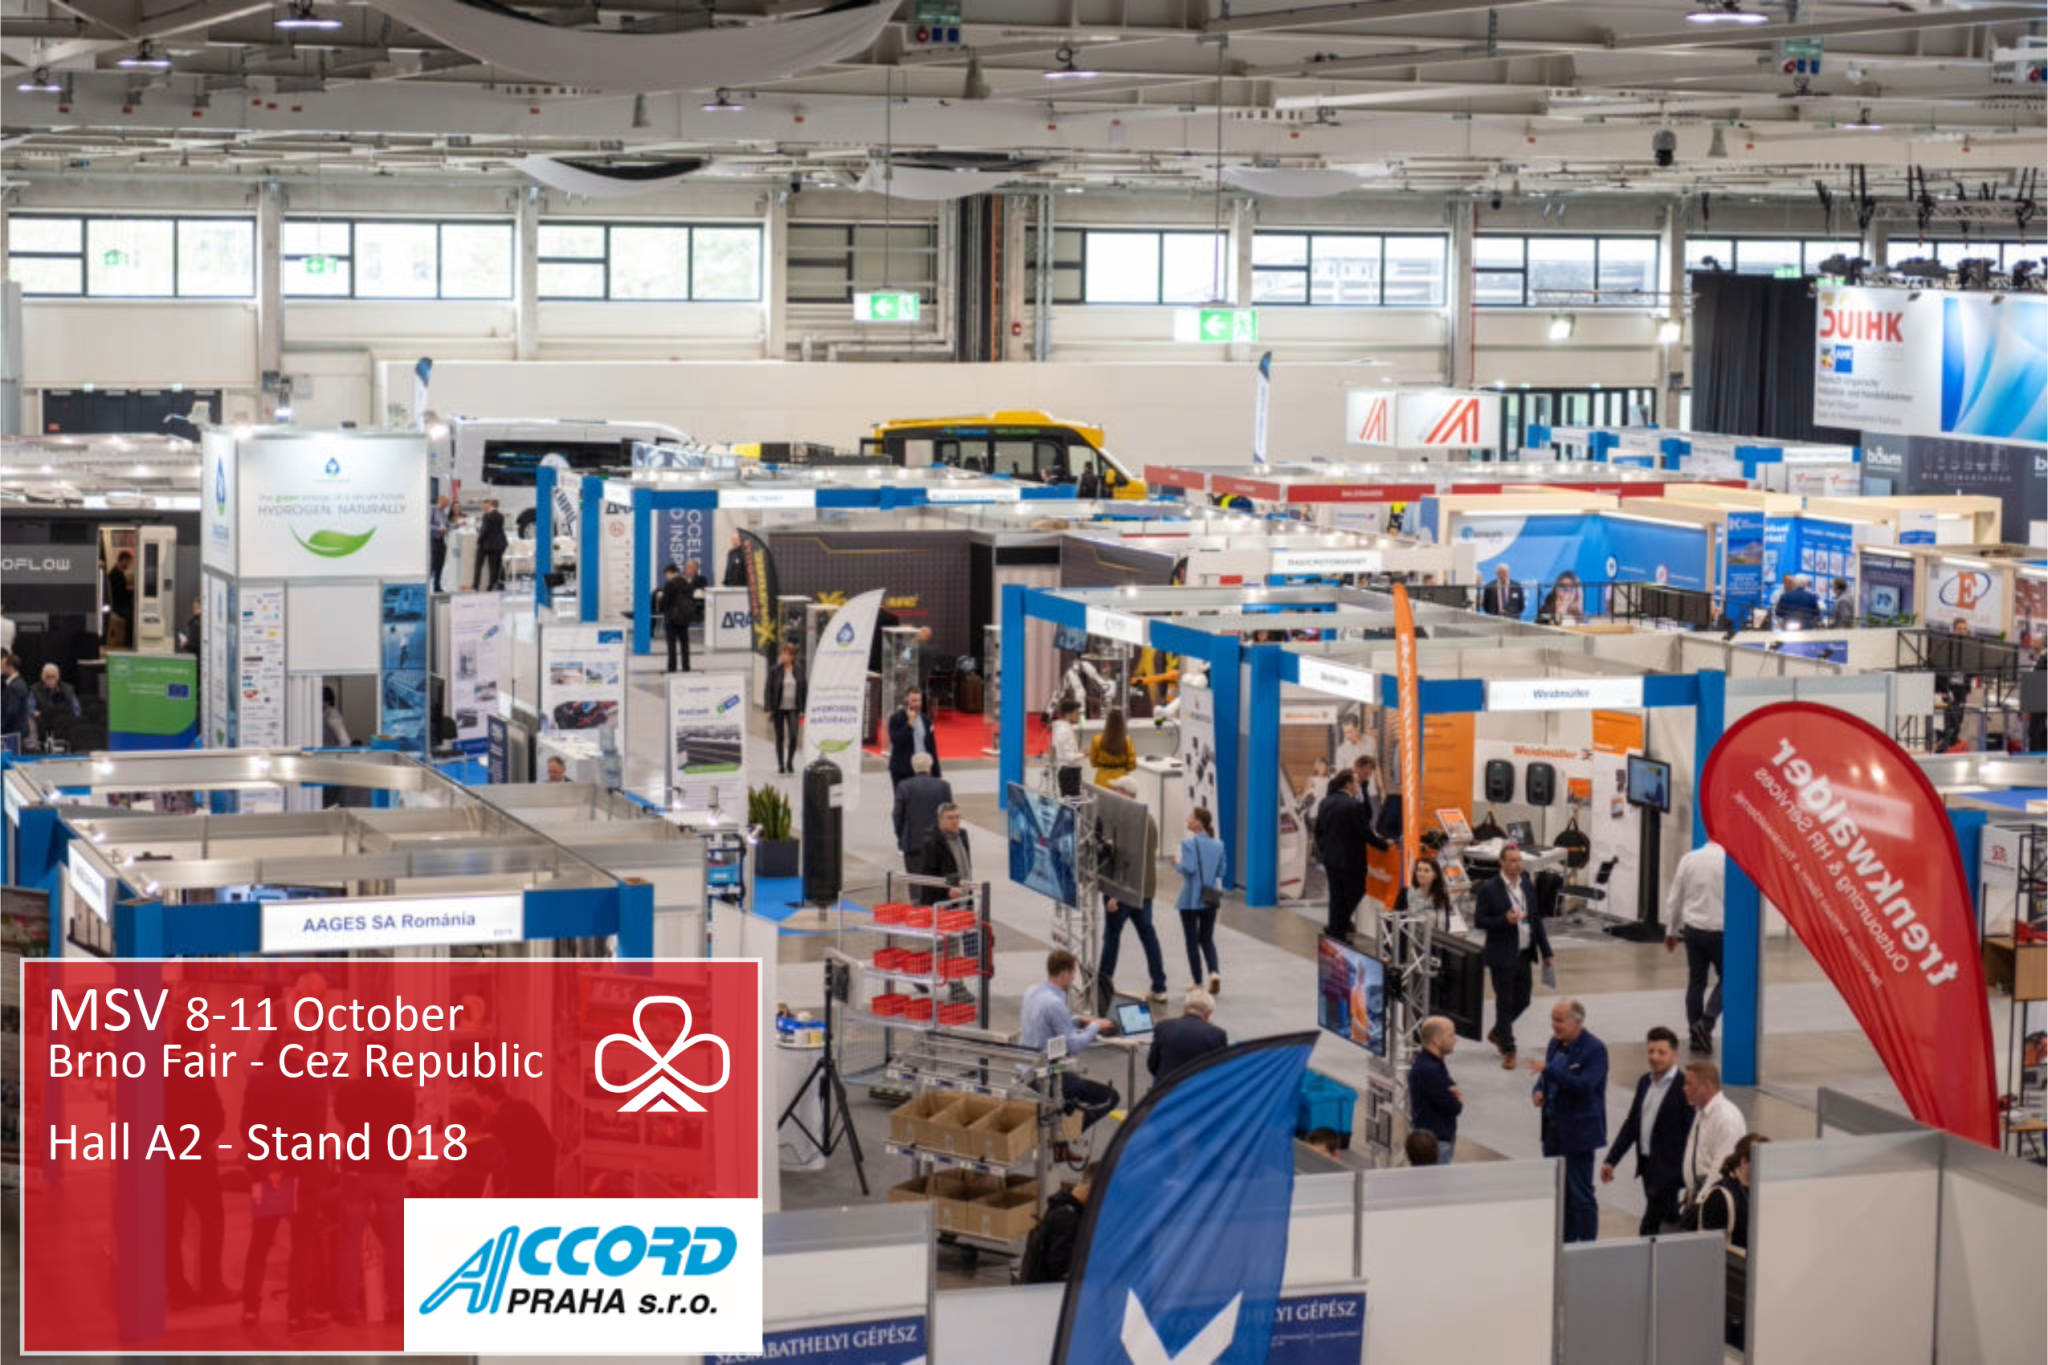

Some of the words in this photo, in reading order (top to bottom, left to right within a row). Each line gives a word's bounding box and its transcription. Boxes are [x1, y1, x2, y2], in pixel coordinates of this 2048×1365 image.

[338, 503, 407, 515] NATURALLY
[1533, 688, 1590, 699] Weidmüller
[1514, 746, 1578, 759] Weidmüller
[303, 915, 367, 932] AAGES
[371, 914, 396, 930] SA
[401, 911, 476, 928] Románia
[1296, 1300, 1358, 1322] GÉPÉSZ
[852, 1324, 918, 1348] GÉPÉSZ
